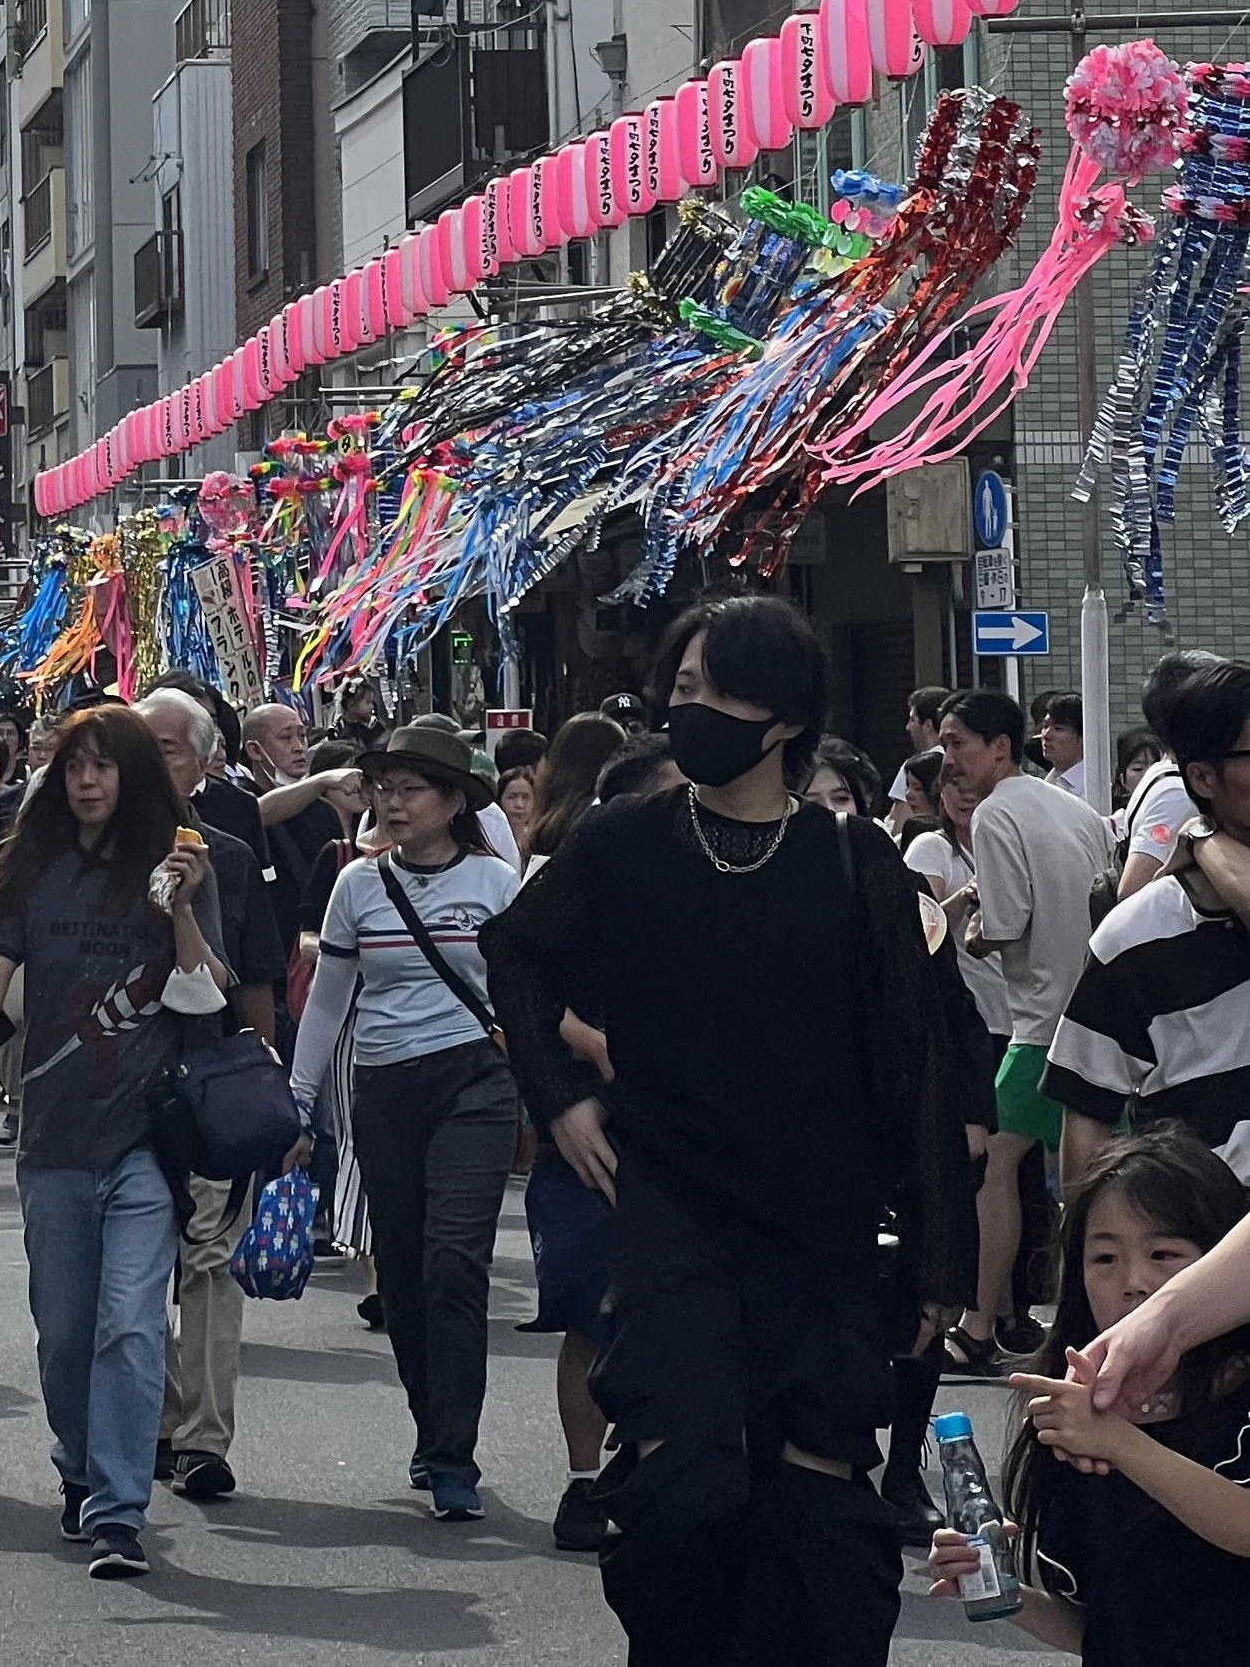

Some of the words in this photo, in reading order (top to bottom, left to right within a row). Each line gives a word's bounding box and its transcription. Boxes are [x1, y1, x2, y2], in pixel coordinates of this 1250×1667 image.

[722, 67, 736, 155] 下町七夕まつり
[800, 23, 815, 118] 下町七夕まつり
[628, 122, 641, 203] 下町七夕まつり
[647, 107, 659, 191] 下町七夕まつり
